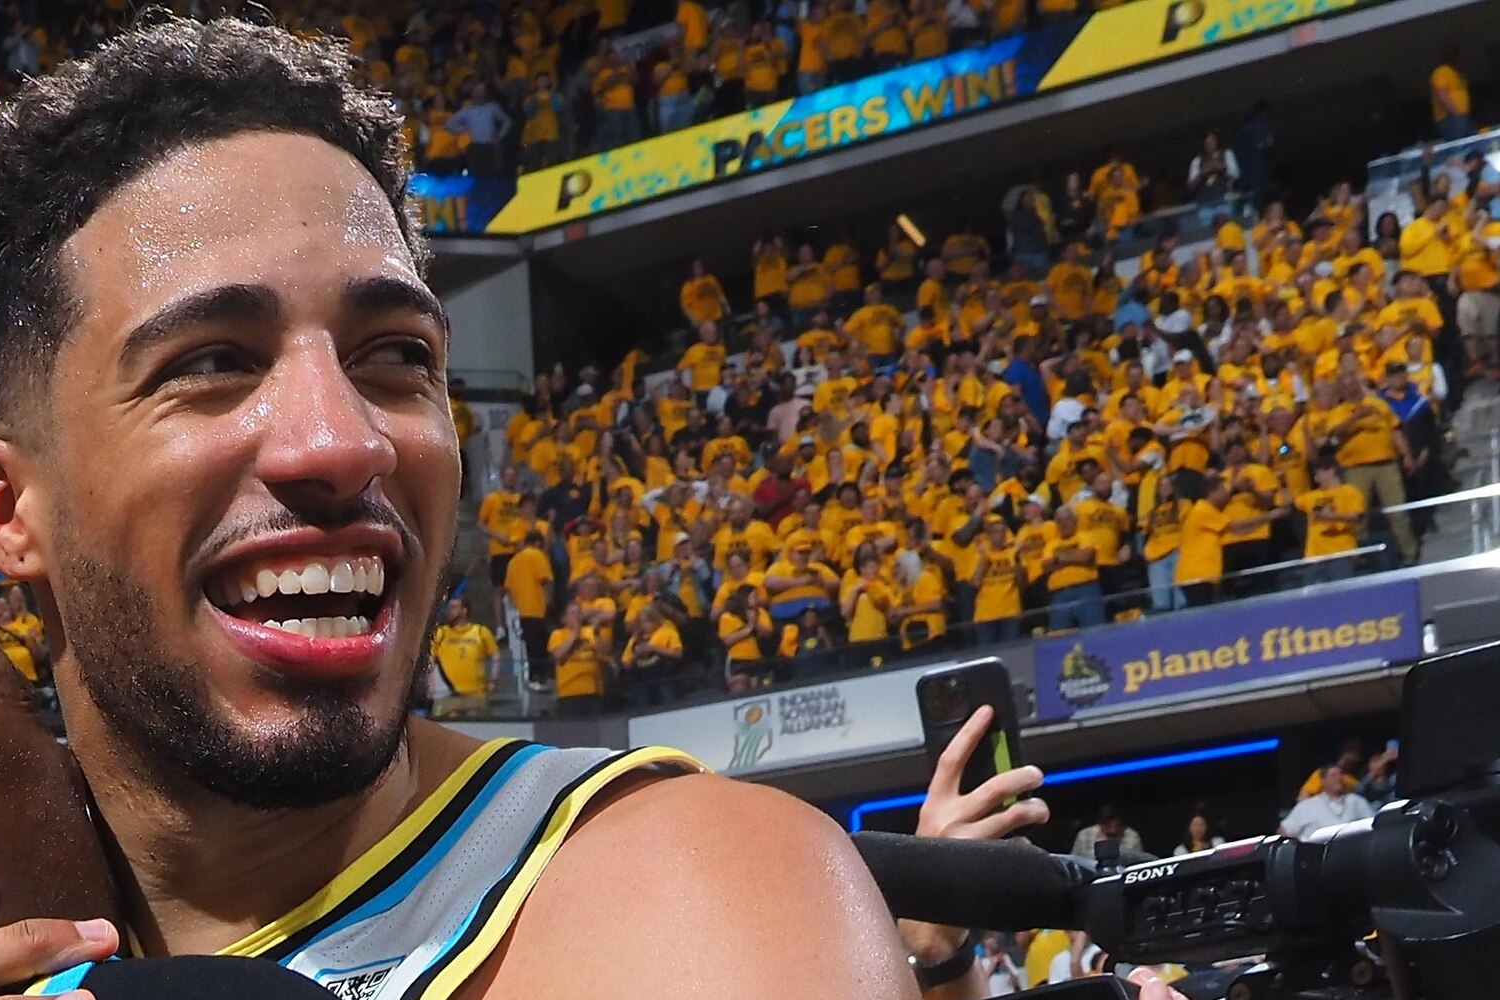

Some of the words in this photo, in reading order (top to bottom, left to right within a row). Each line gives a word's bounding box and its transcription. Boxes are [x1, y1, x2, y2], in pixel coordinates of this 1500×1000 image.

[713, 96, 889, 177] PACERS
[902, 61, 1016, 122] WIN!
[1124, 636, 1250, 692] planet
[1261, 613, 1401, 661] fitness
[1124, 863, 1180, 884] SONY
